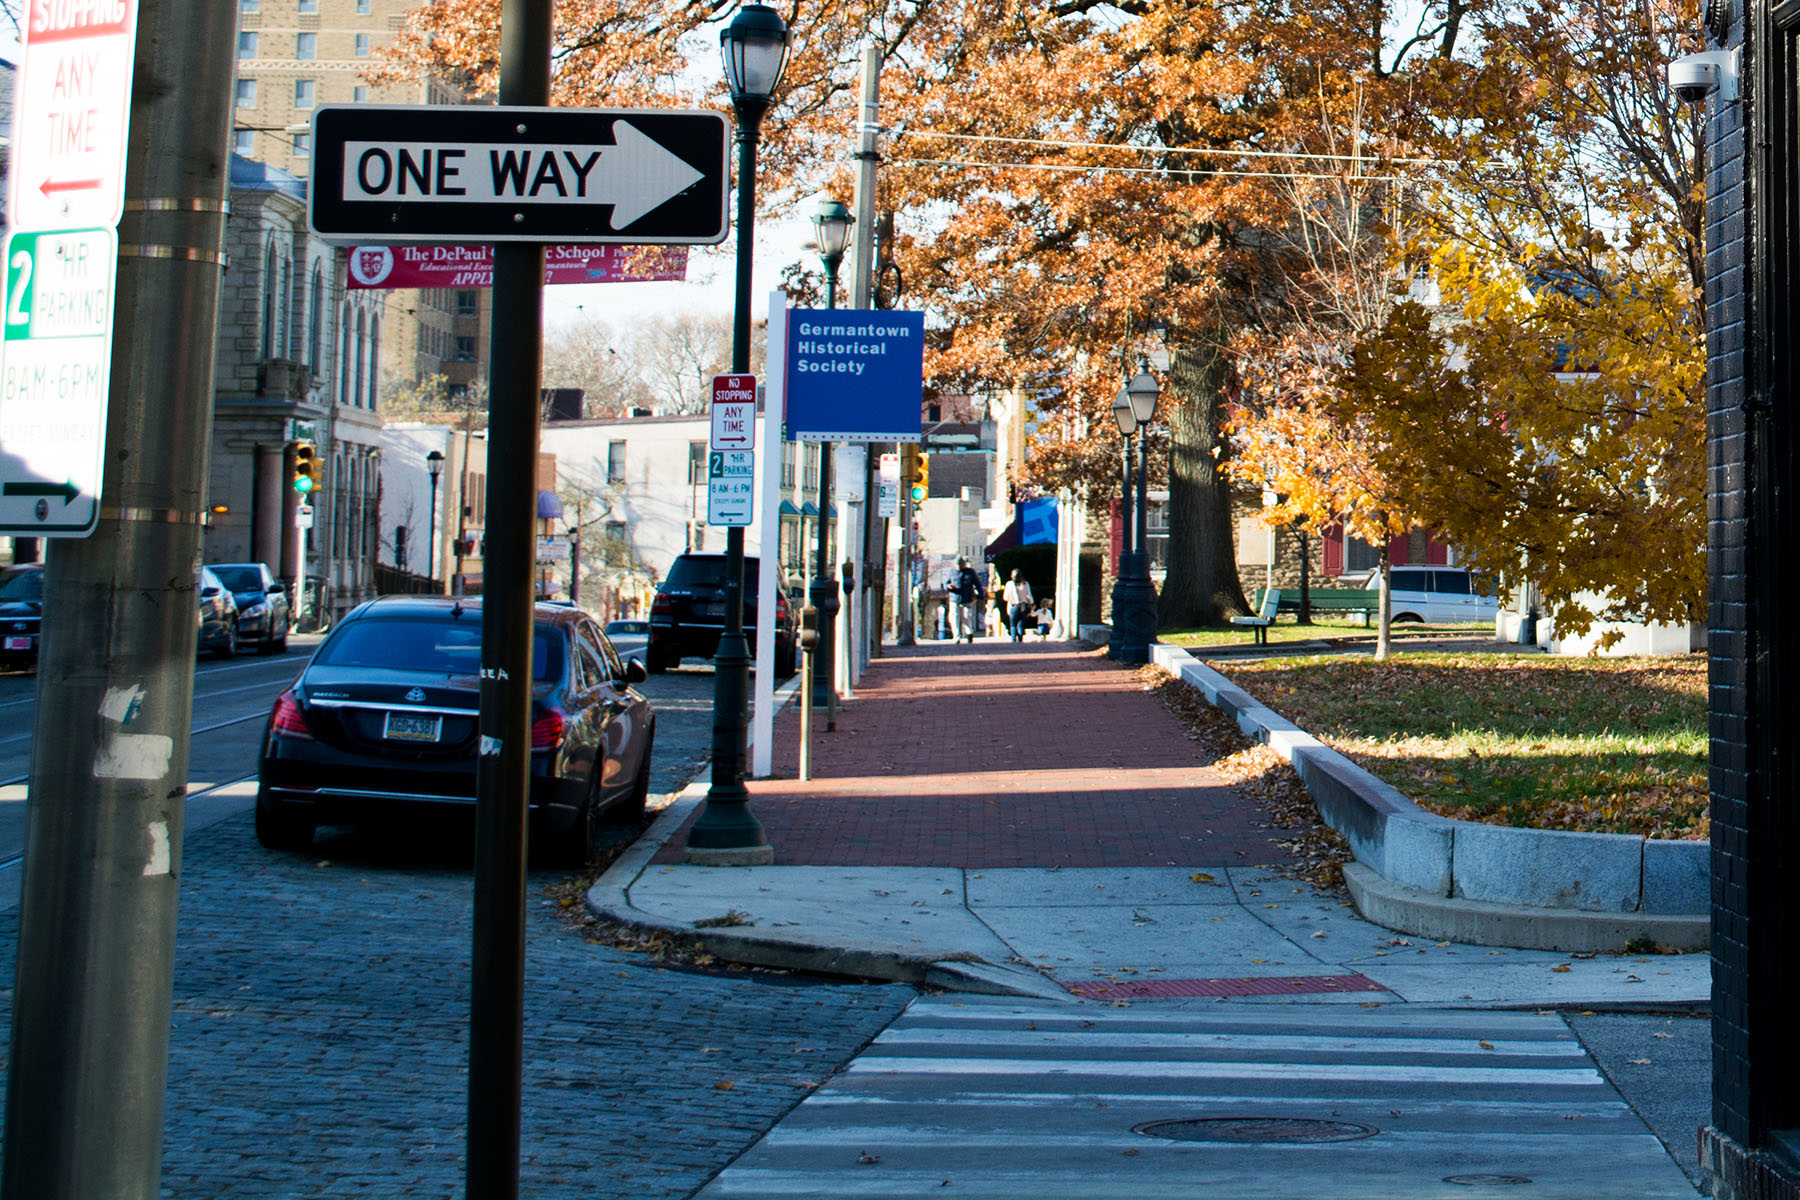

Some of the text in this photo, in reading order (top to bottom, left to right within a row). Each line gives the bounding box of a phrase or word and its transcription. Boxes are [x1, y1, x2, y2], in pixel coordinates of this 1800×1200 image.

[53, 55, 98, 99] ANY
[46, 109, 97, 156] TIME
[357, 147, 602, 198] ONE WAY
[402, 246, 430, 261] The
[433, 245, 487, 261] DePaul
[555, 245, 606, 259] School
[7, 242, 90, 327] 2 HR
[40, 288, 105, 327] PARKING
[799, 323, 910, 338] Germantown
[797, 341, 887, 355] Historical
[797, 359, 866, 376] Society
[728, 377, 740, 389] NO
[715, 390, 753, 401] STOPPING
[724, 406, 744, 419] ANY
[723, 420, 744, 433] TIME
[712, 453, 745, 475] 2 HR
[724, 465, 752, 476] PARKING
